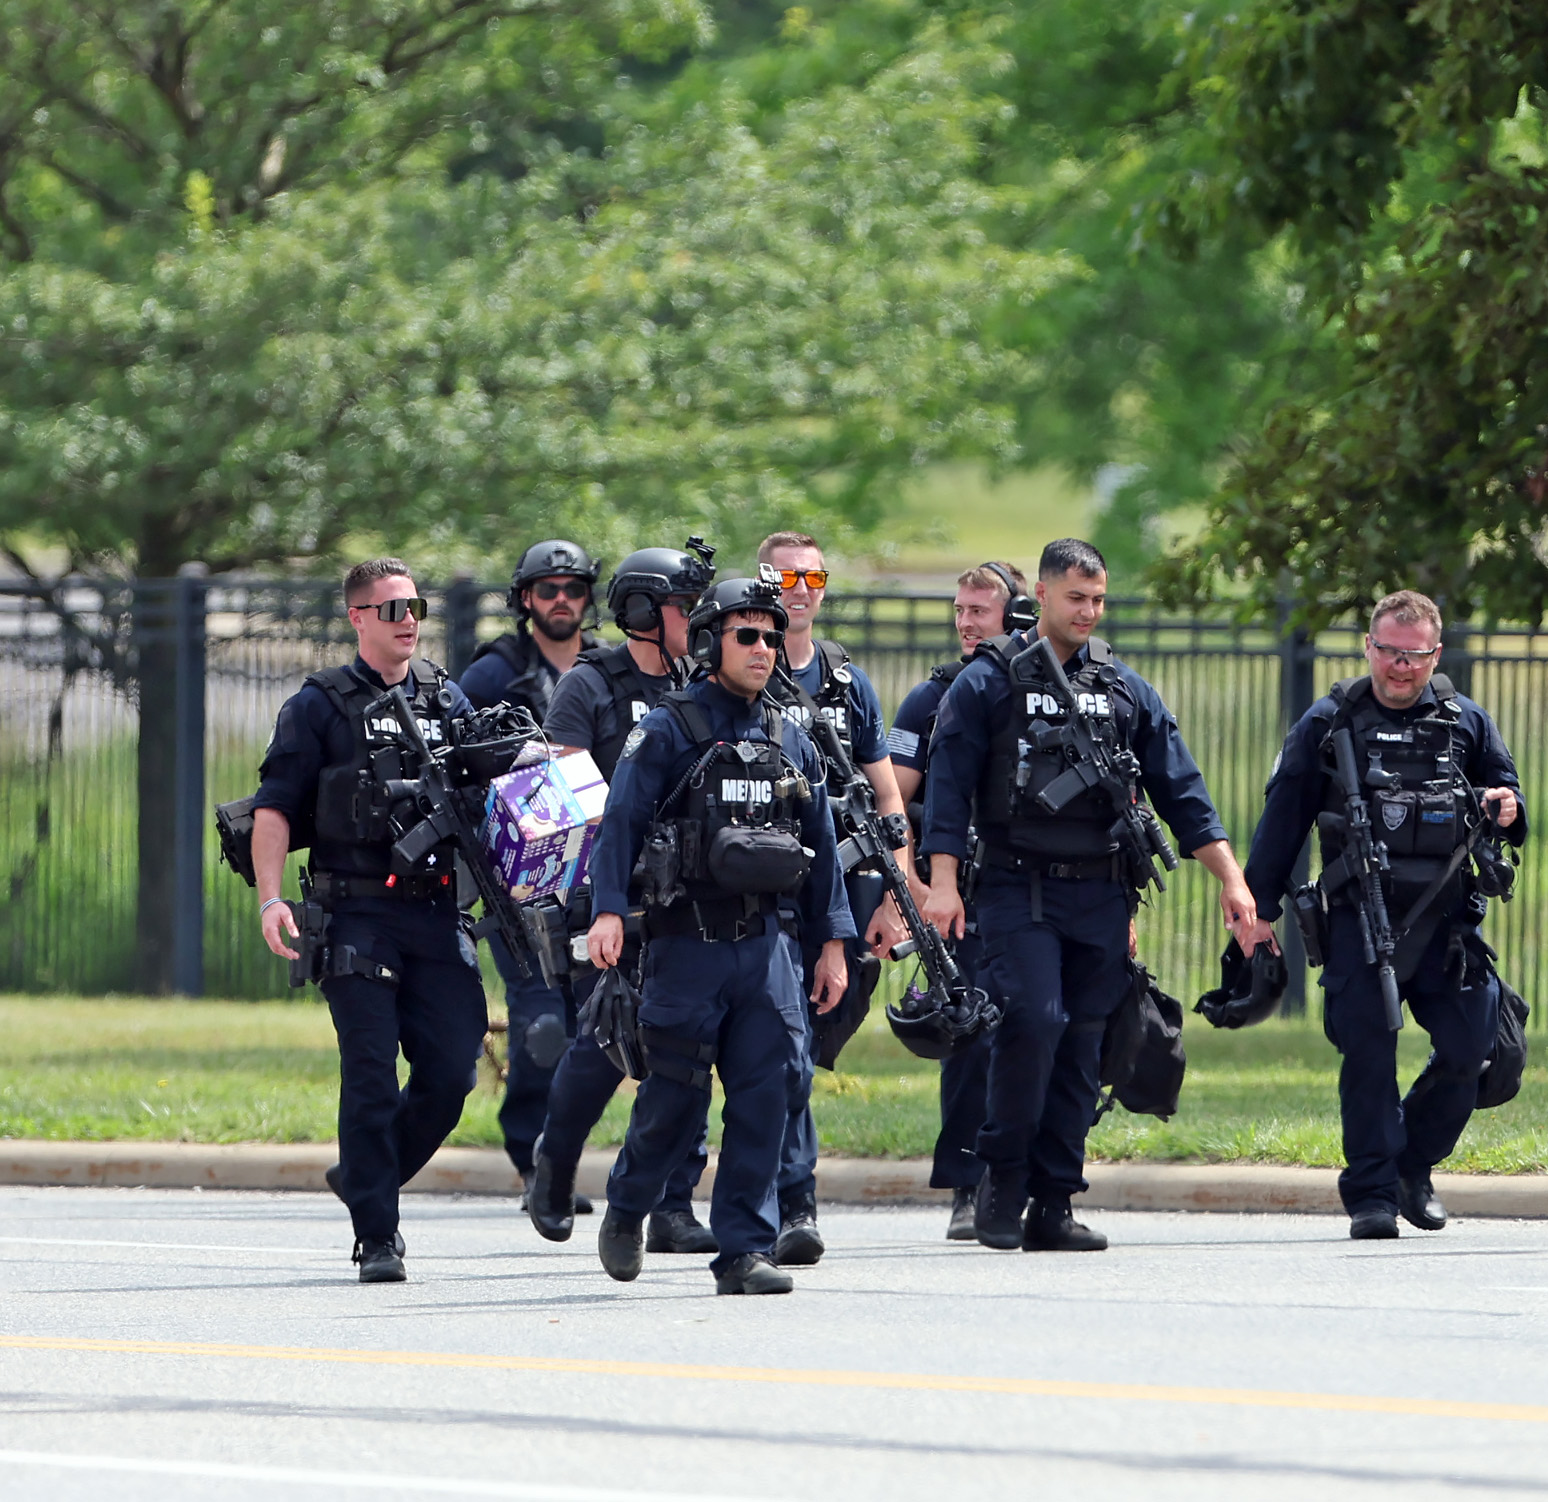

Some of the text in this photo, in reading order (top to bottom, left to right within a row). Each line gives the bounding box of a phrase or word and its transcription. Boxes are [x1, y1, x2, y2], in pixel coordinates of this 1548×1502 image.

[1026, 692, 1110, 715] POCE
[364, 717, 443, 741] POCE
[780, 705, 847, 730] OCE
[1376, 731, 1403, 741] POLICE
[722, 778, 773, 804] MEDIC
